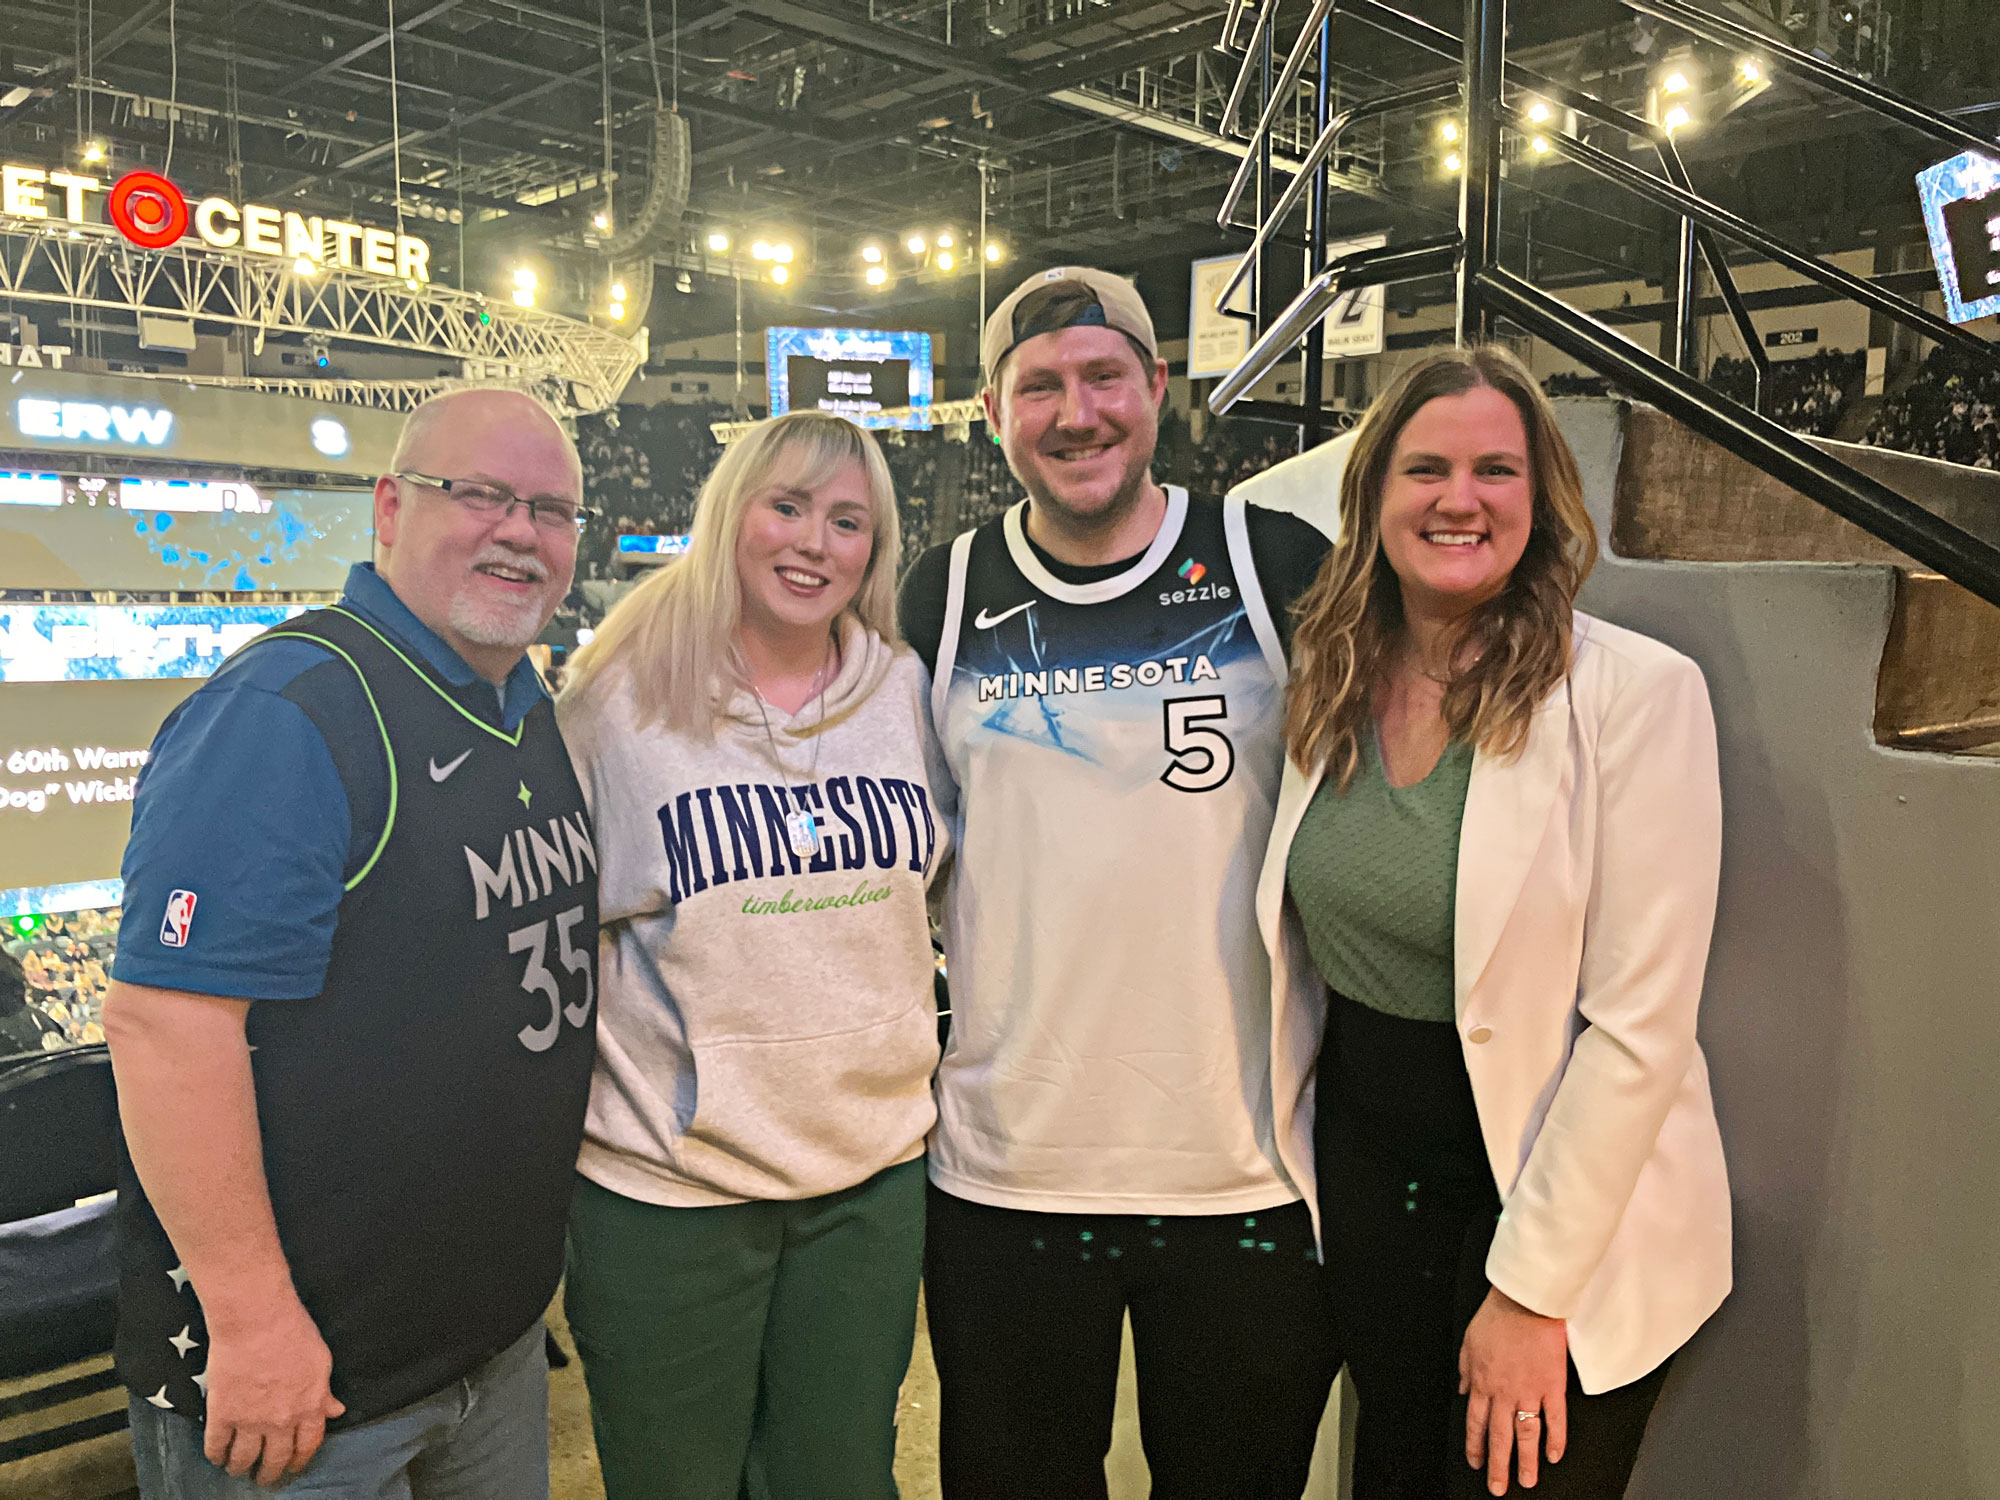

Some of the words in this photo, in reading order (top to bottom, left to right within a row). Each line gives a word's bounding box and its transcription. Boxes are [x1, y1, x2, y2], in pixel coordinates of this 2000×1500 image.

[2, 164, 100, 225] ET
[195, 197, 430, 283] CENTER
[1780, 331, 1803, 345] 202
[17, 398, 173, 446] ERW
[1159, 582, 1231, 606] sezzle
[978, 654, 1220, 702] MINNESOTA
[6, 747, 70, 774] 60th
[1160, 694, 1236, 793] 5
[464, 810, 598, 921] MINN
[741, 880, 894, 914] timberwolves
[508, 904, 594, 1053] 35
